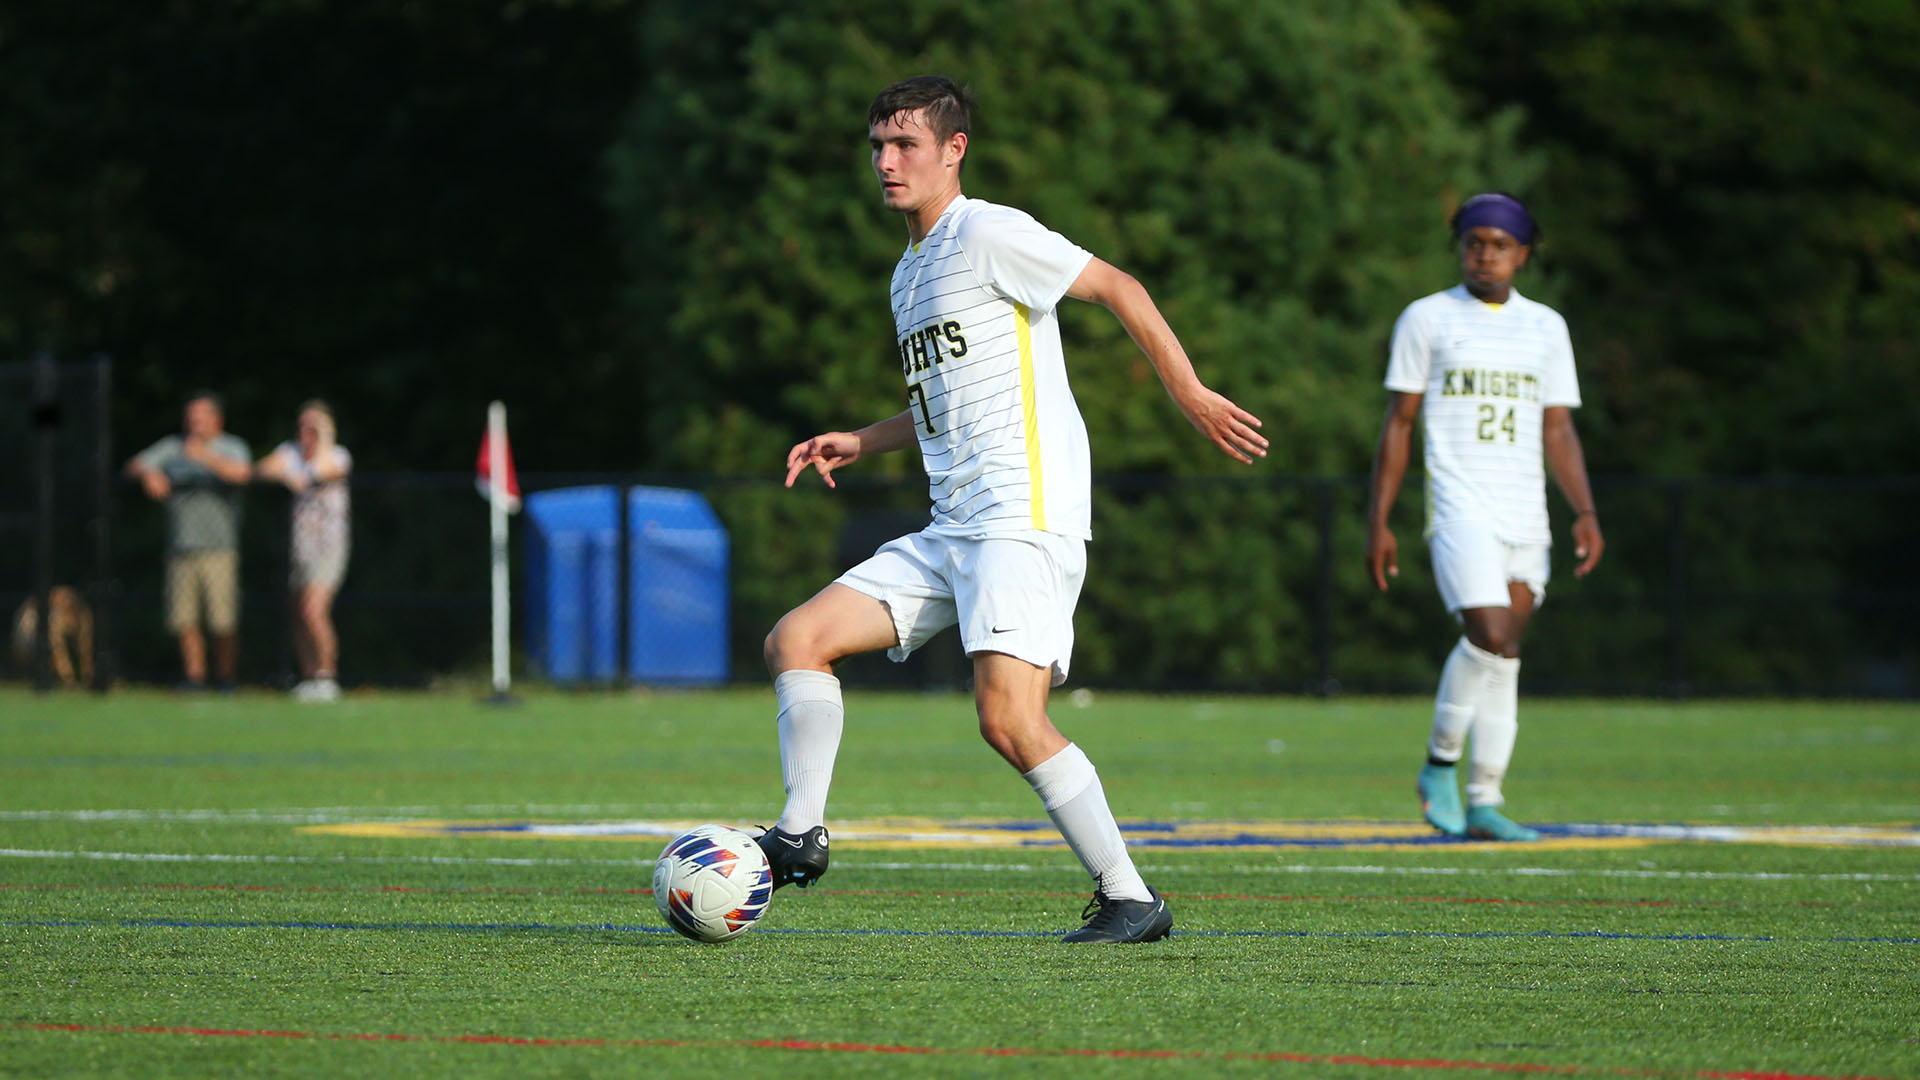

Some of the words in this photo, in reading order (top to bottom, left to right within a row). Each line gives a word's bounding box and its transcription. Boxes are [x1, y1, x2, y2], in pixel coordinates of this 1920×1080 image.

[1442, 368, 1538, 402] KNIGHT
[908, 381, 936, 434] 7
[1477, 402, 1515, 444] 24
